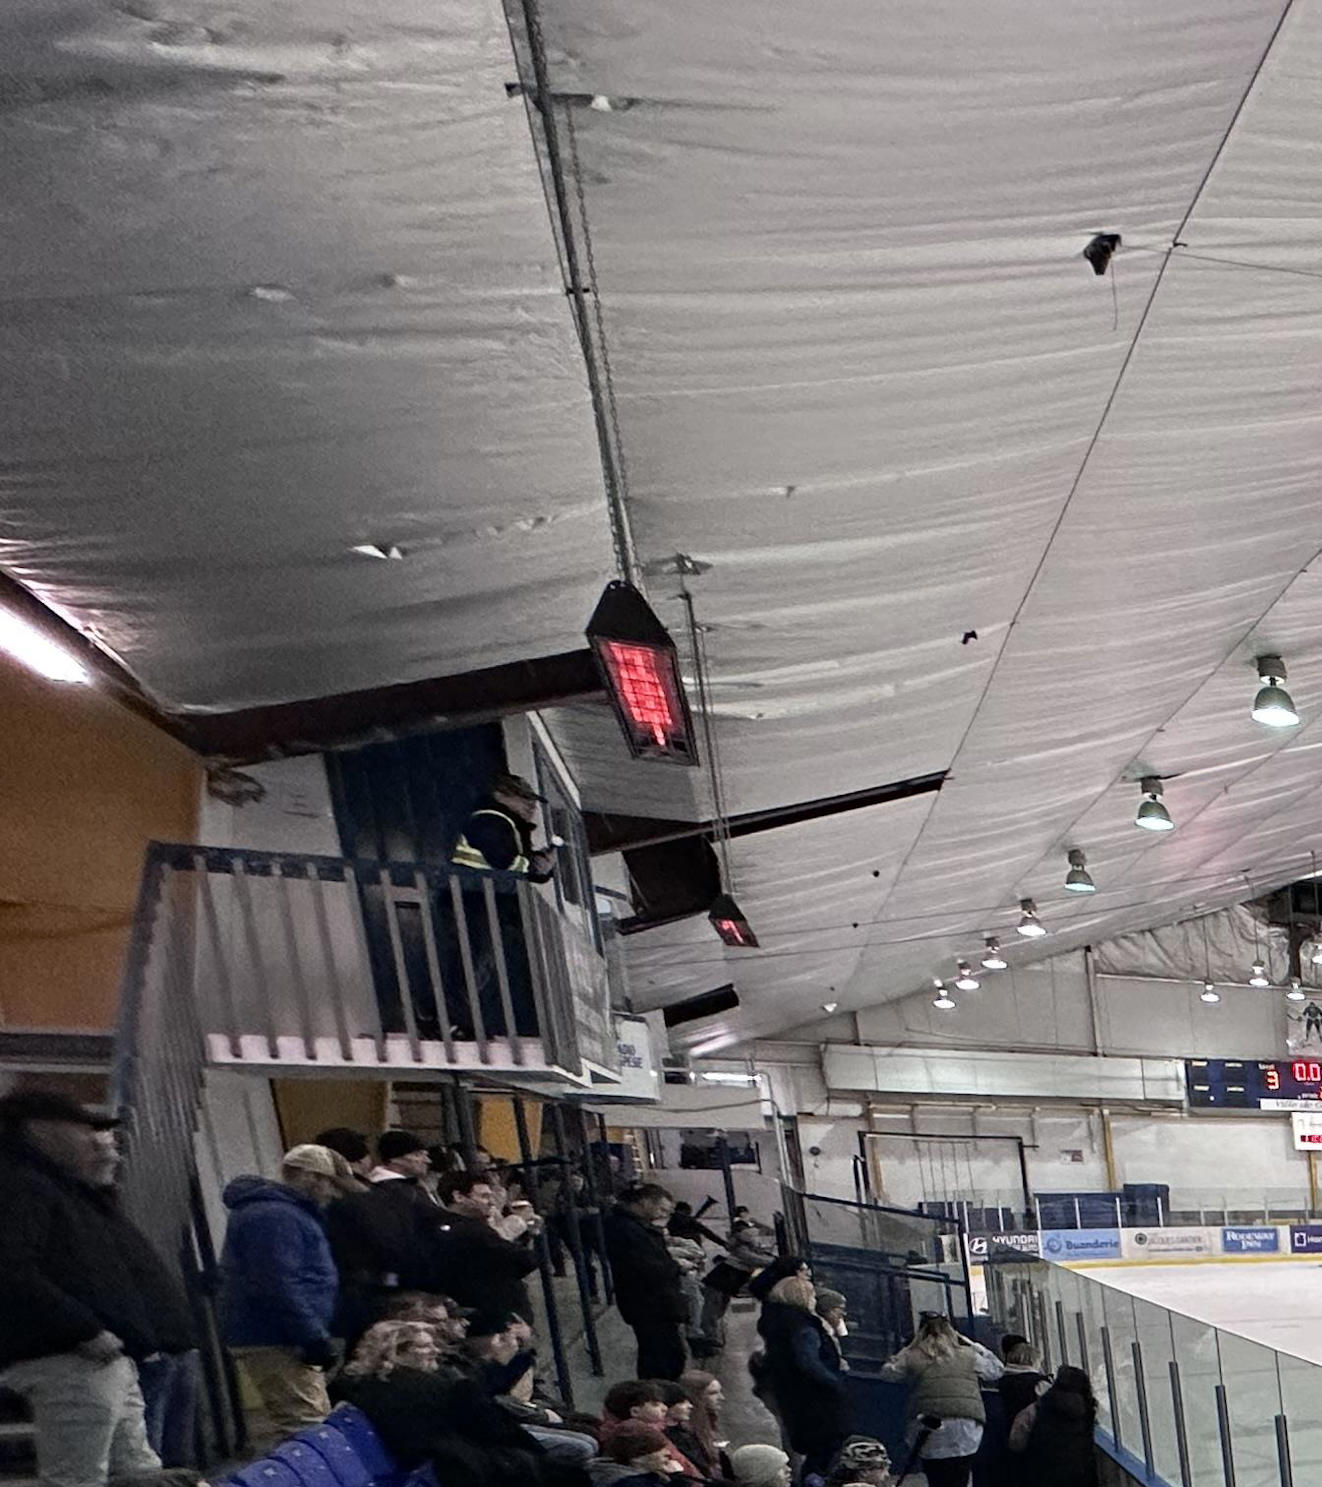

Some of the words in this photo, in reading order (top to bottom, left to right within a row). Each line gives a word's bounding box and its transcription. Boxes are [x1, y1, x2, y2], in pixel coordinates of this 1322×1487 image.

[1267, 1071, 1279, 1090] 3
[1295, 1062, 1321, 1081] 0.0
[1065, 1239, 1120, 1250] Buanderie
